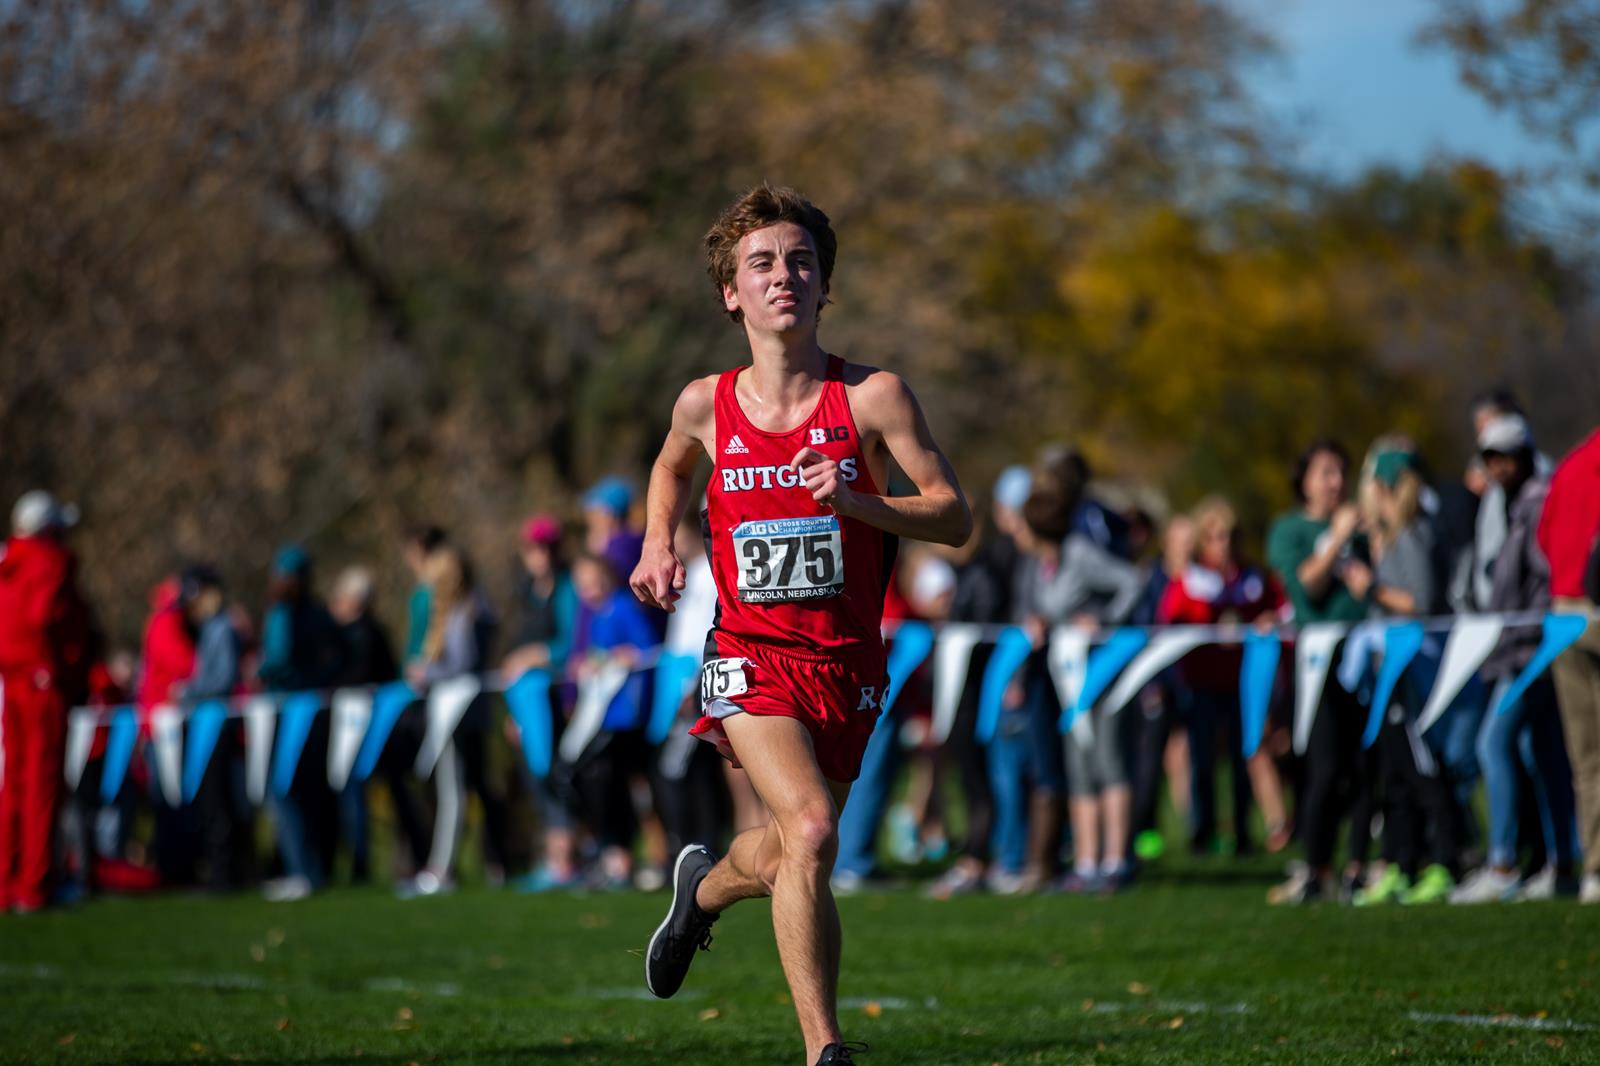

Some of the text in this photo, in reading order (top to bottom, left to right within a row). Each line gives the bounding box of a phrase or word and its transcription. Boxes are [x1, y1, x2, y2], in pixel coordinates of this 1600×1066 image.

[725, 447, 749, 455] adidas
[721, 457, 858, 492] RUTGS
[779, 525, 832, 533] CHAMPIONSHIPS
[743, 533, 835, 588] 375
[746, 587, 836, 599] LINCOLN, NEBRASKA
